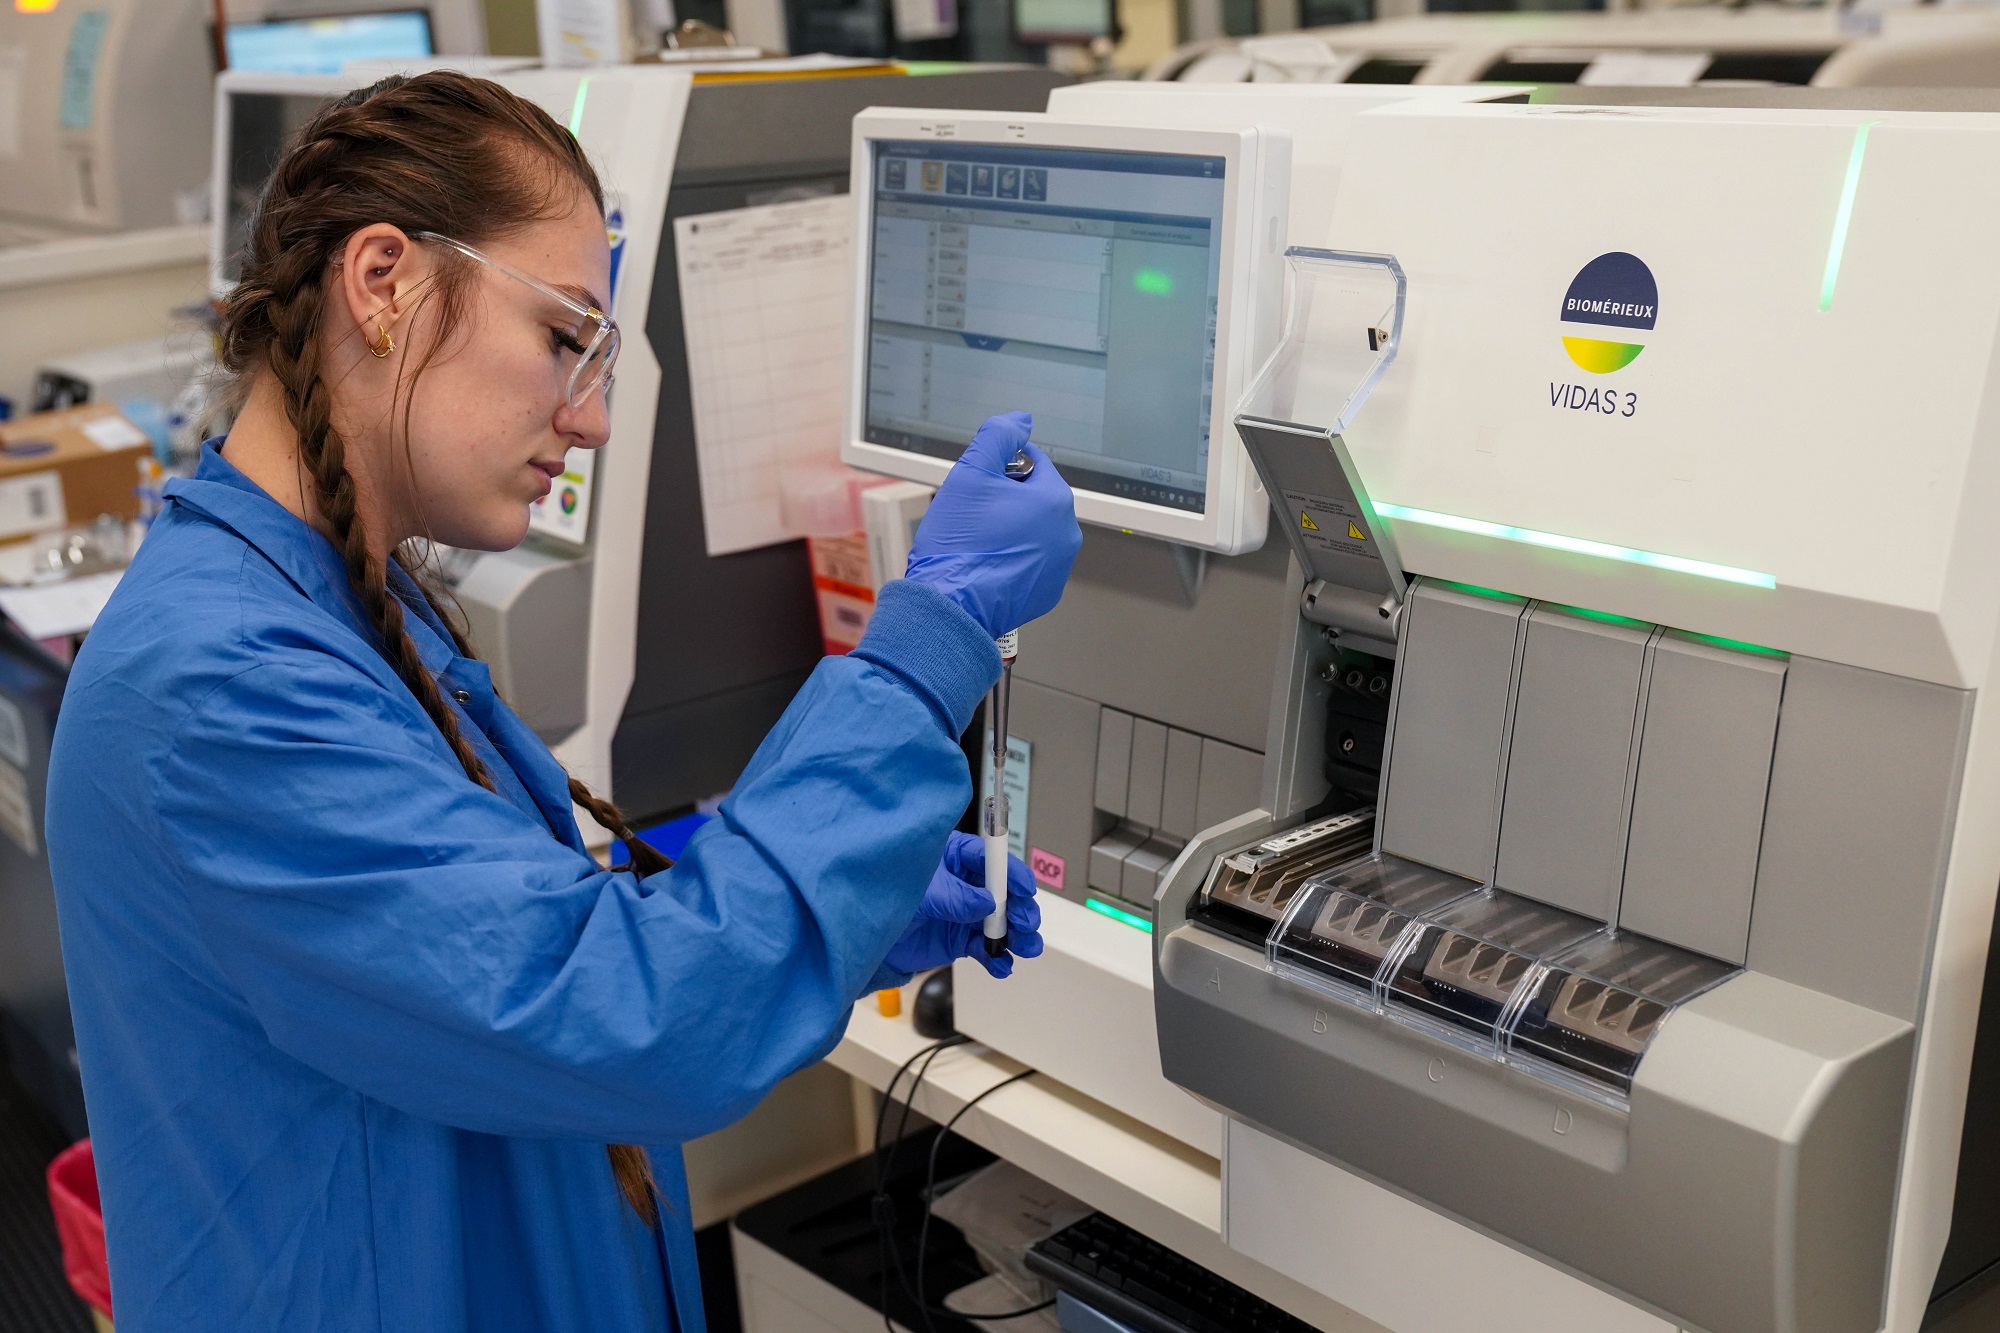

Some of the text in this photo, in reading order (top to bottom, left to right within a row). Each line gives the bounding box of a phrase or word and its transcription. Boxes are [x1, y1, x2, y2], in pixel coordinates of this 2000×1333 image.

[1567, 298, 1654, 318] BIOMÉRIEUX
[1550, 382, 1637, 418] VIDAS 3
[1033, 855, 1061, 879] IQCP
[1206, 967, 1221, 993] A
[1312, 1009, 1328, 1035] B
[1427, 1056, 1446, 1083] C
[1552, 1107, 1574, 1136] D
